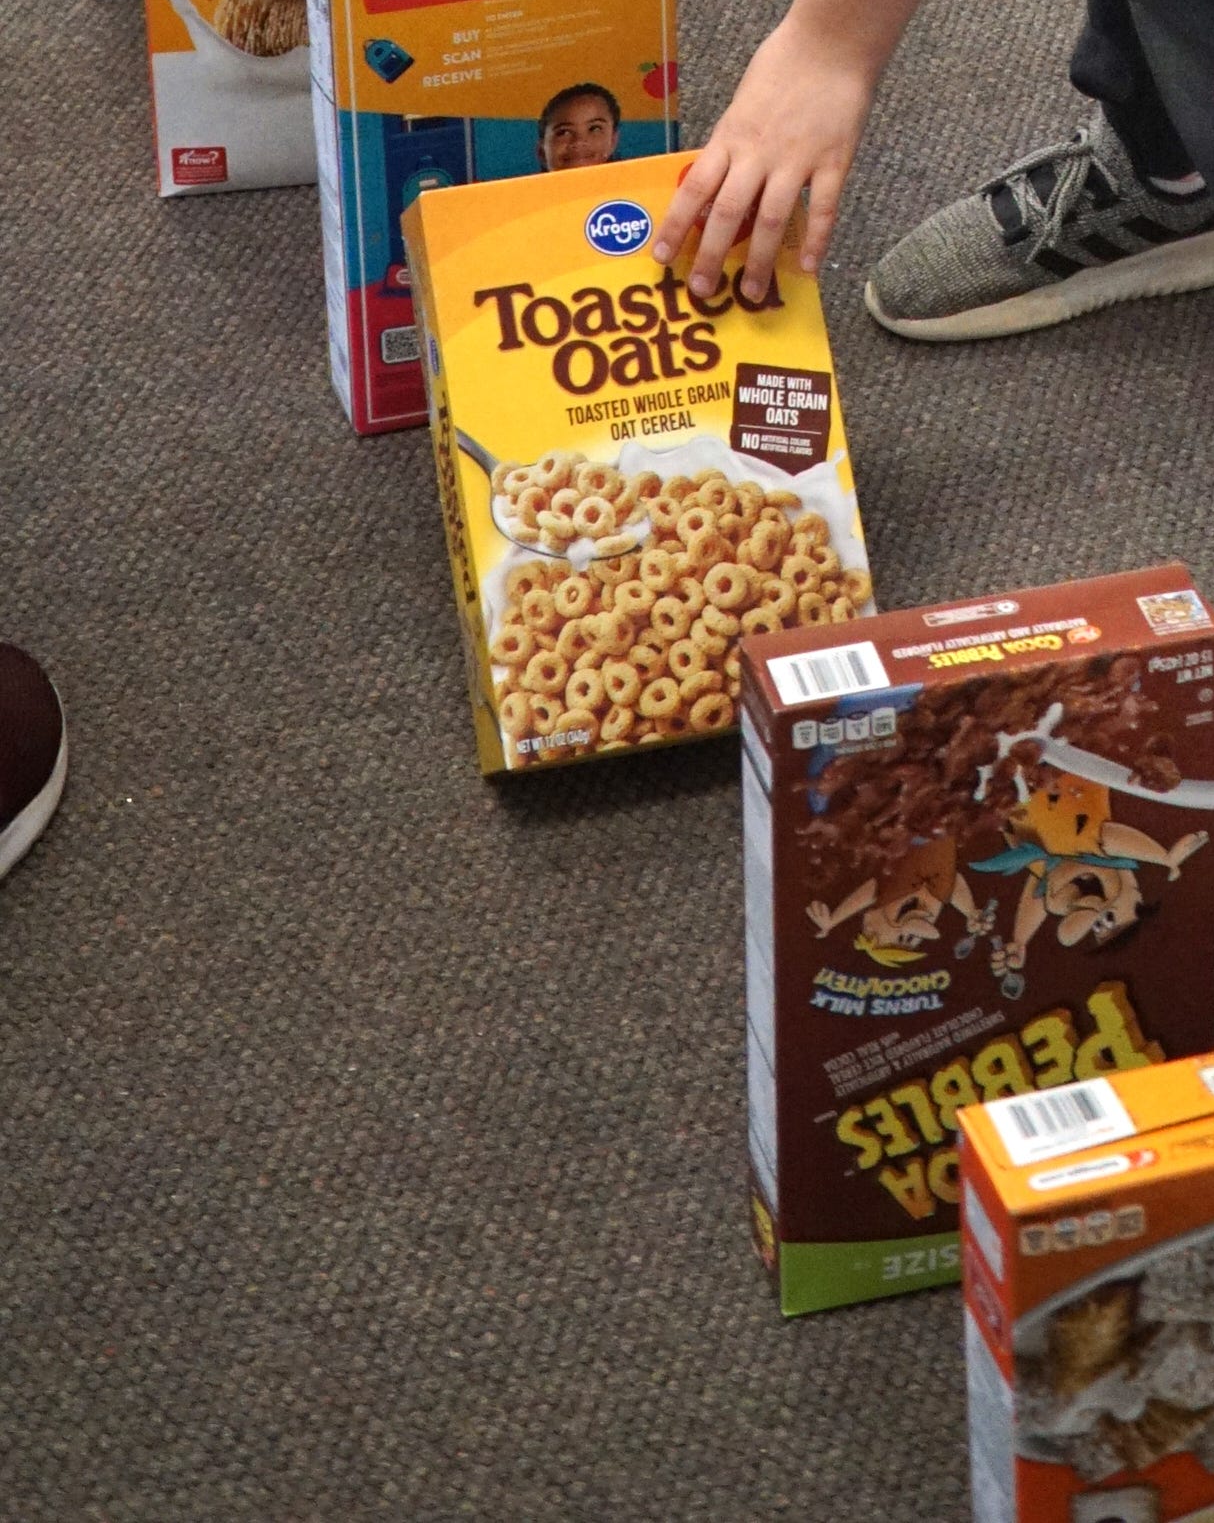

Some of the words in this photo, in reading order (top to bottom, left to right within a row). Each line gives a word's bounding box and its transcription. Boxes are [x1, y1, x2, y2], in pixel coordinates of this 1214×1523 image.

[453, 29, 480, 44] BUY
[442, 49, 481, 65] SCAN
[423, 68, 483, 87] RECEIVE
[590, 213, 647, 244] Kroger
[551, 321, 723, 395] Oats
[757, 374, 785, 388] MADE
[787, 377, 812, 391] WITH
[566, 399, 630, 426] TOASTED
[633, 389, 683, 414] WHOLE
[688, 381, 731, 405] GRAIN
[739, 386, 785, 406] WHOLE
[788, 391, 828, 411] GRAIN
[611, 419, 637, 440] OAT
[641, 410, 696, 435] CEREAL
[766, 407, 799, 426] OATS
[741, 433, 760, 450] NO
[810, 991, 867, 1017] MILK
[870, 994, 943, 1016] TURNS
[835, 980, 1166, 1171] PEBBLES
[882, 1244, 960, 1281] SIZE
